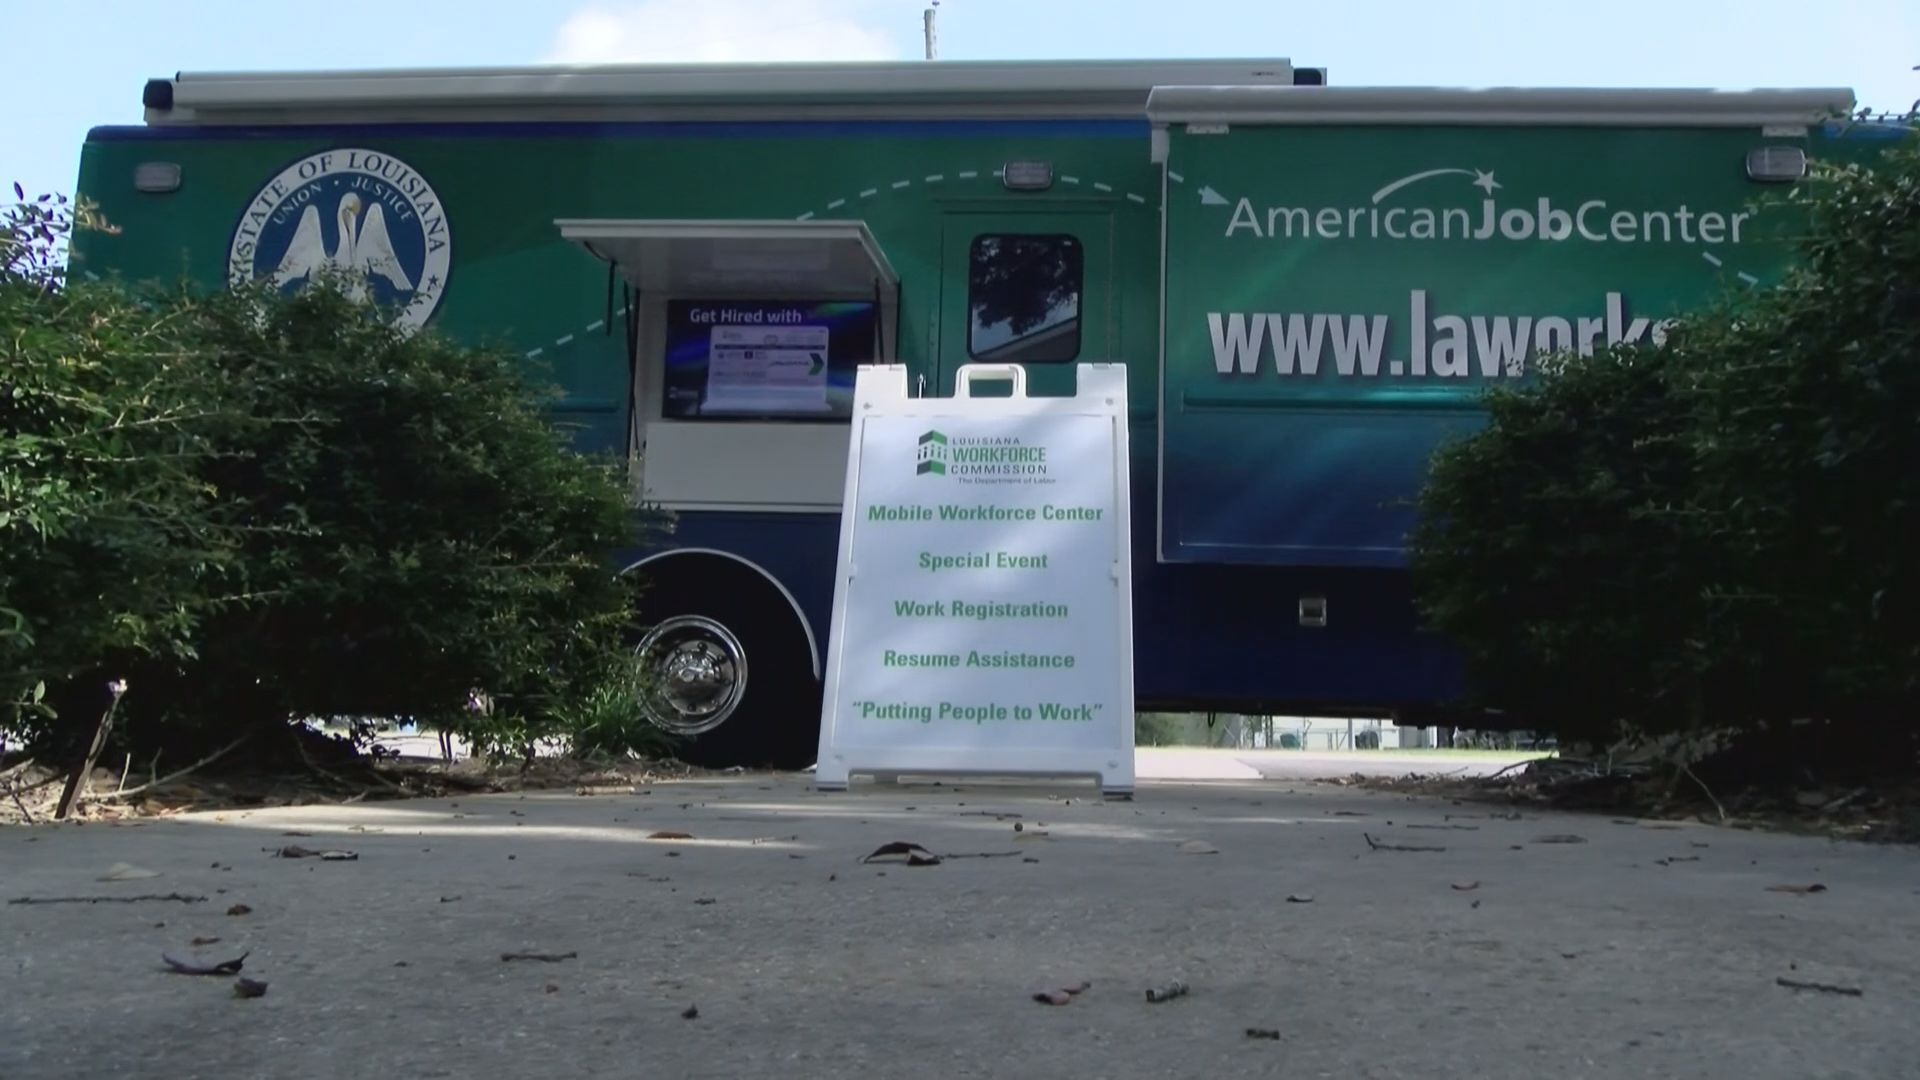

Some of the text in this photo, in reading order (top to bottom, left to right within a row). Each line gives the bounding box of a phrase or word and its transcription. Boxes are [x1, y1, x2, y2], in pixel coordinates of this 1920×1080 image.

[236, 152, 446, 257] STATE OF LOUISIANA
[273, 176, 414, 225] UNION JUSTICE
[690, 308, 802, 323] Get Hired with
[952, 437, 1021, 446] LOUISIANA
[952, 447, 1047, 463] WORKFORCE
[951, 464, 1048, 475] COMMISSION
[868, 505, 1103, 521] Mobile Workforce Center
[919, 552, 1048, 572] Special Event
[895, 600, 1069, 620] Work Registration
[884, 650, 1075, 668] Resume Assistance
[938, 703, 1008, 724] People
[1013, 705, 1033, 721] to
